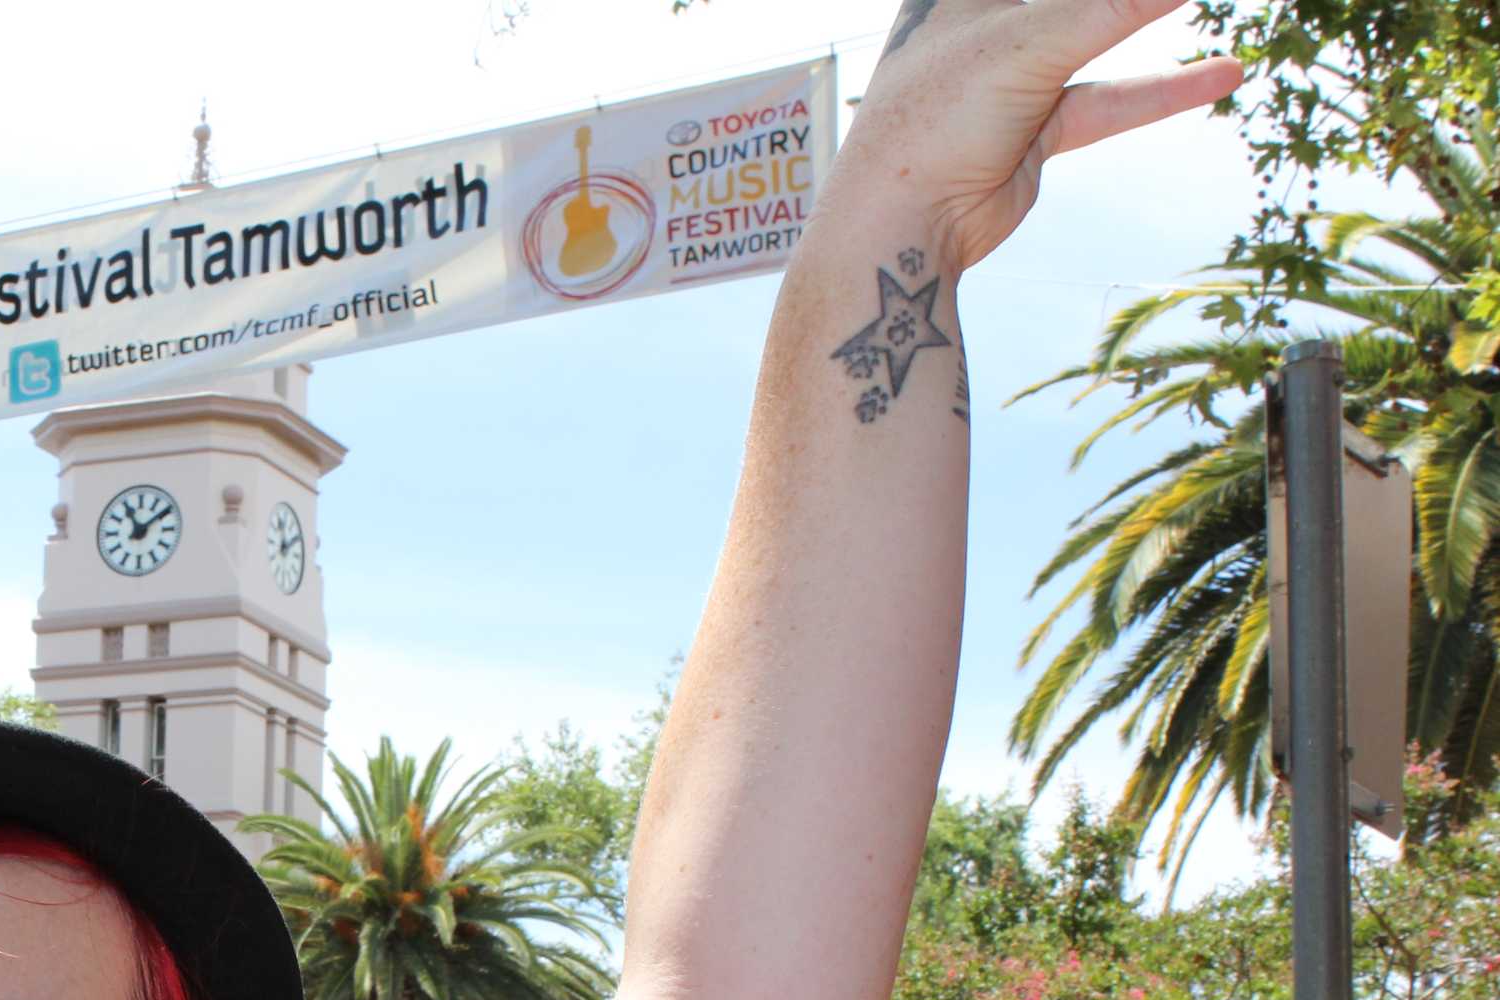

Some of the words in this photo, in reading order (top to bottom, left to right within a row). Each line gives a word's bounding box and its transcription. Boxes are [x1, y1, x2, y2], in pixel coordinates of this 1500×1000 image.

[708, 99, 809, 137] TOYOTA
[668, 125, 810, 179] COUNTRY
[668, 155, 812, 214] MUSIC
[170, 162, 489, 289] Tamworth
[666, 197, 808, 243] FESTIVAL
[67, 280, 439, 374] twitter.com/tcmf_official
